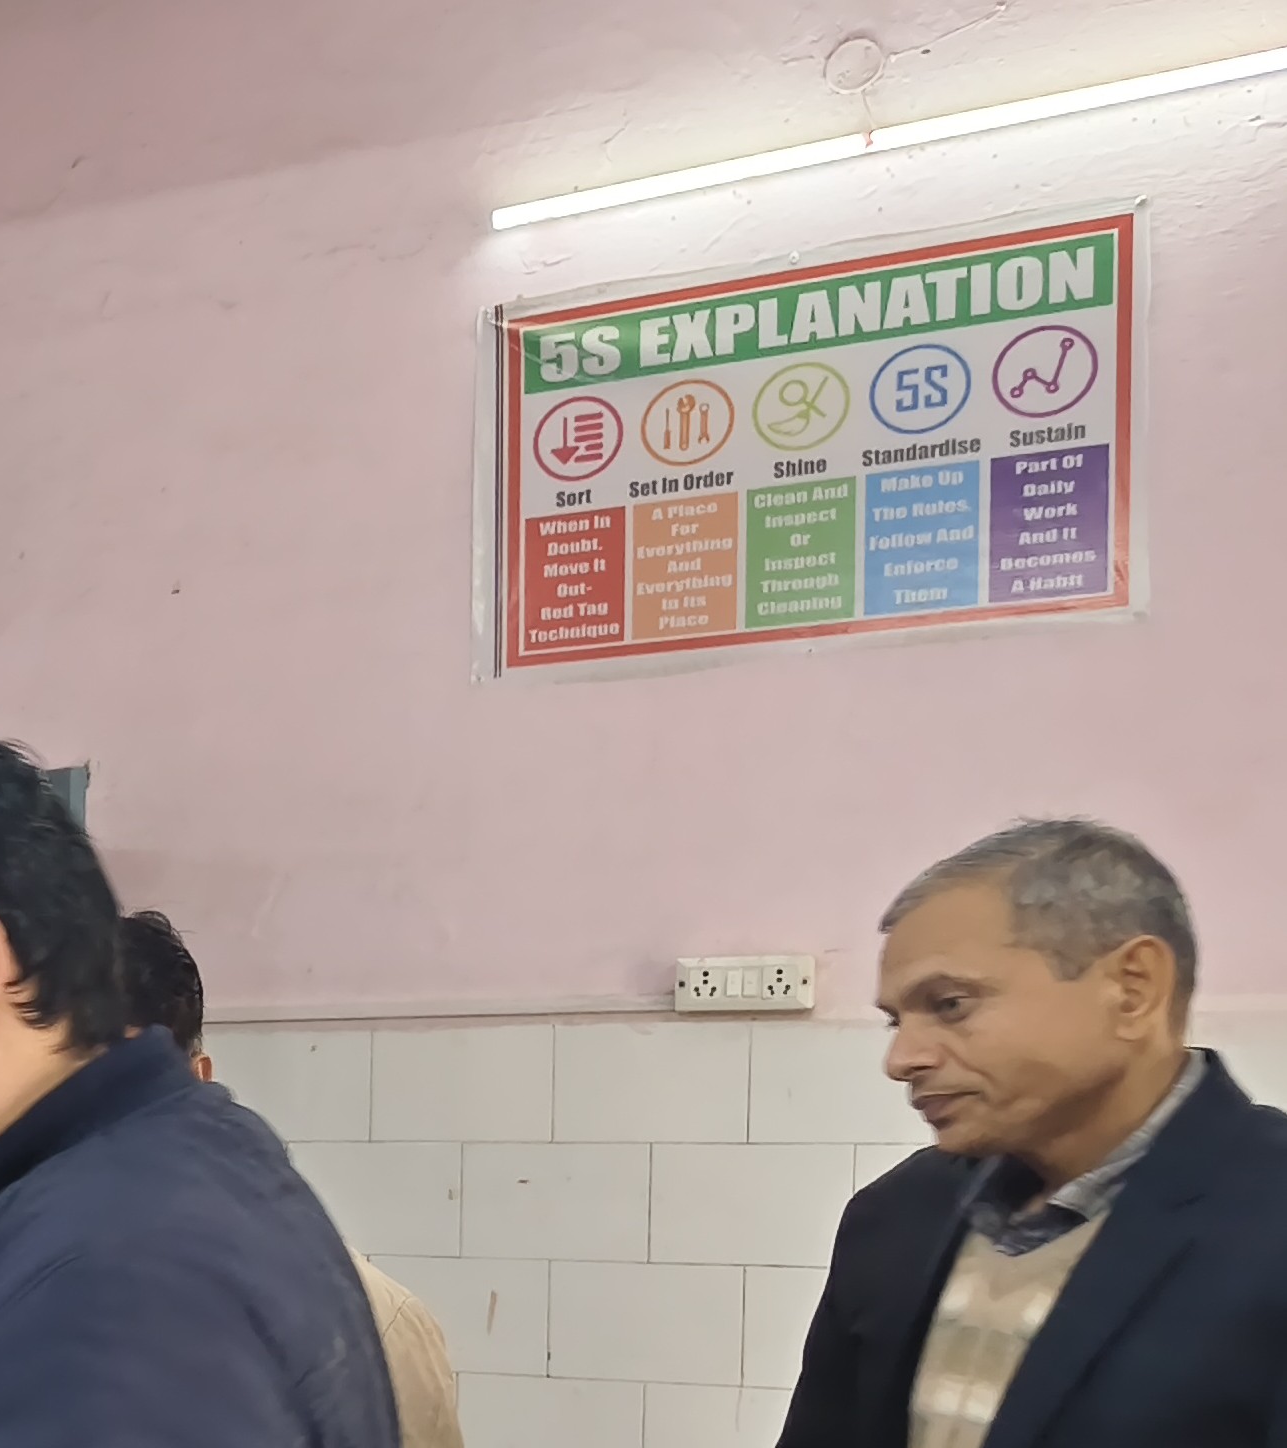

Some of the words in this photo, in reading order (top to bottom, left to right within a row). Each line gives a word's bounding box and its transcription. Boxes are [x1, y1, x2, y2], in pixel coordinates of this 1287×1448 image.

[539, 325, 621, 384] 5S
[639, 246, 1095, 368] EXPLANATION
[895, 365, 949, 413] 5S
[1009, 422, 1086, 448] Sustain
[862, 437, 981, 467] Standardise
[773, 458, 827, 479] Shine
[1015, 457, 1058, 475] Part
[1062, 453, 1084, 468] Of
[629, 480, 658, 498] Set
[662, 477, 679, 494] In
[683, 471, 734, 491] Order
[880, 474, 933, 493] Make
[938, 469, 964, 486] Up
[1022, 480, 1076, 498] Daily
[556, 489, 592, 508] Sort
[754, 490, 808, 509] Clean
[812, 483, 848, 500] And
[651, 508, 663, 521] A
[667, 502, 718, 519] Place
[765, 508, 837, 528] Inspect
[872, 506, 907, 522] The
[1023, 503, 1078, 521] Work
[539, 518, 589, 536] When
[594, 515, 611, 529] In
[671, 523, 699, 537] For
[790, 533, 811, 547] Or
[868, 531, 932, 551] Follow
[936, 525, 975, 544] And
[1018, 528, 1058, 546] And
[1062, 527, 1077, 541] It
[637, 537, 733, 559] Everything
[543, 561, 590, 578] Move
[594, 558, 606, 573] It
[667, 557, 701, 573] And
[764, 552, 836, 571] Inspect
[883, 557, 959, 577] Enforce
[1000, 550, 1097, 571] Becomes
[637, 574, 732, 596] Everything
[760, 573, 839, 593] Through
[1011, 577, 1025, 593] A
[1029, 574, 1084, 592] Habit
[662, 598, 679, 610] In
[683, 595, 706, 608] Its
[757, 595, 842, 616] Cleaning
[893, 587, 948, 605] Them
[540, 604, 574, 621] Red
[577, 602, 608, 617] Tag
[659, 614, 709, 630] Place
[528, 622, 620, 643] Technique
